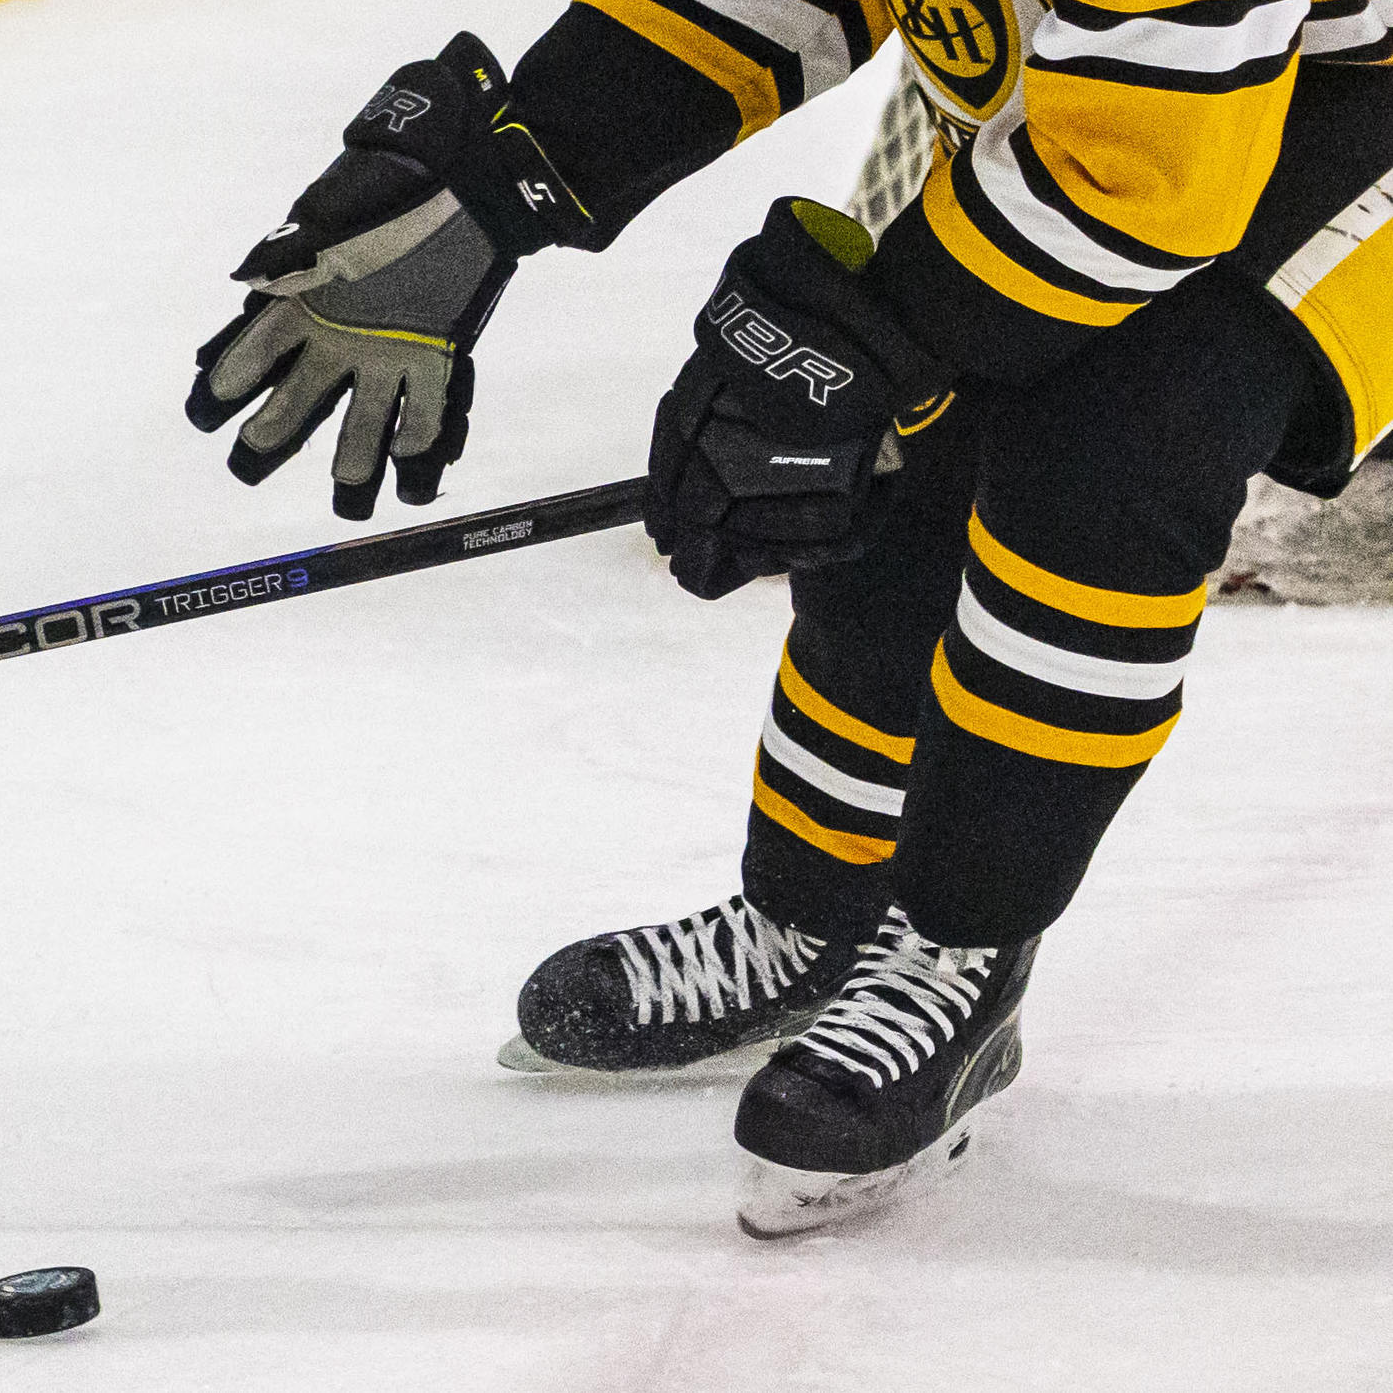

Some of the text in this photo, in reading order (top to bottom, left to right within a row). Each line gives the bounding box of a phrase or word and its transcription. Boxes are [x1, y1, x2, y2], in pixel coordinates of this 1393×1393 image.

[769, 456, 831, 466] SUPREME
[462, 519, 533, 542] PURE CARBON
[463, 528, 533, 551] TECHNOLOGY
[155, 573, 283, 616] TRIGGER
[286, 567, 309, 588] 9
